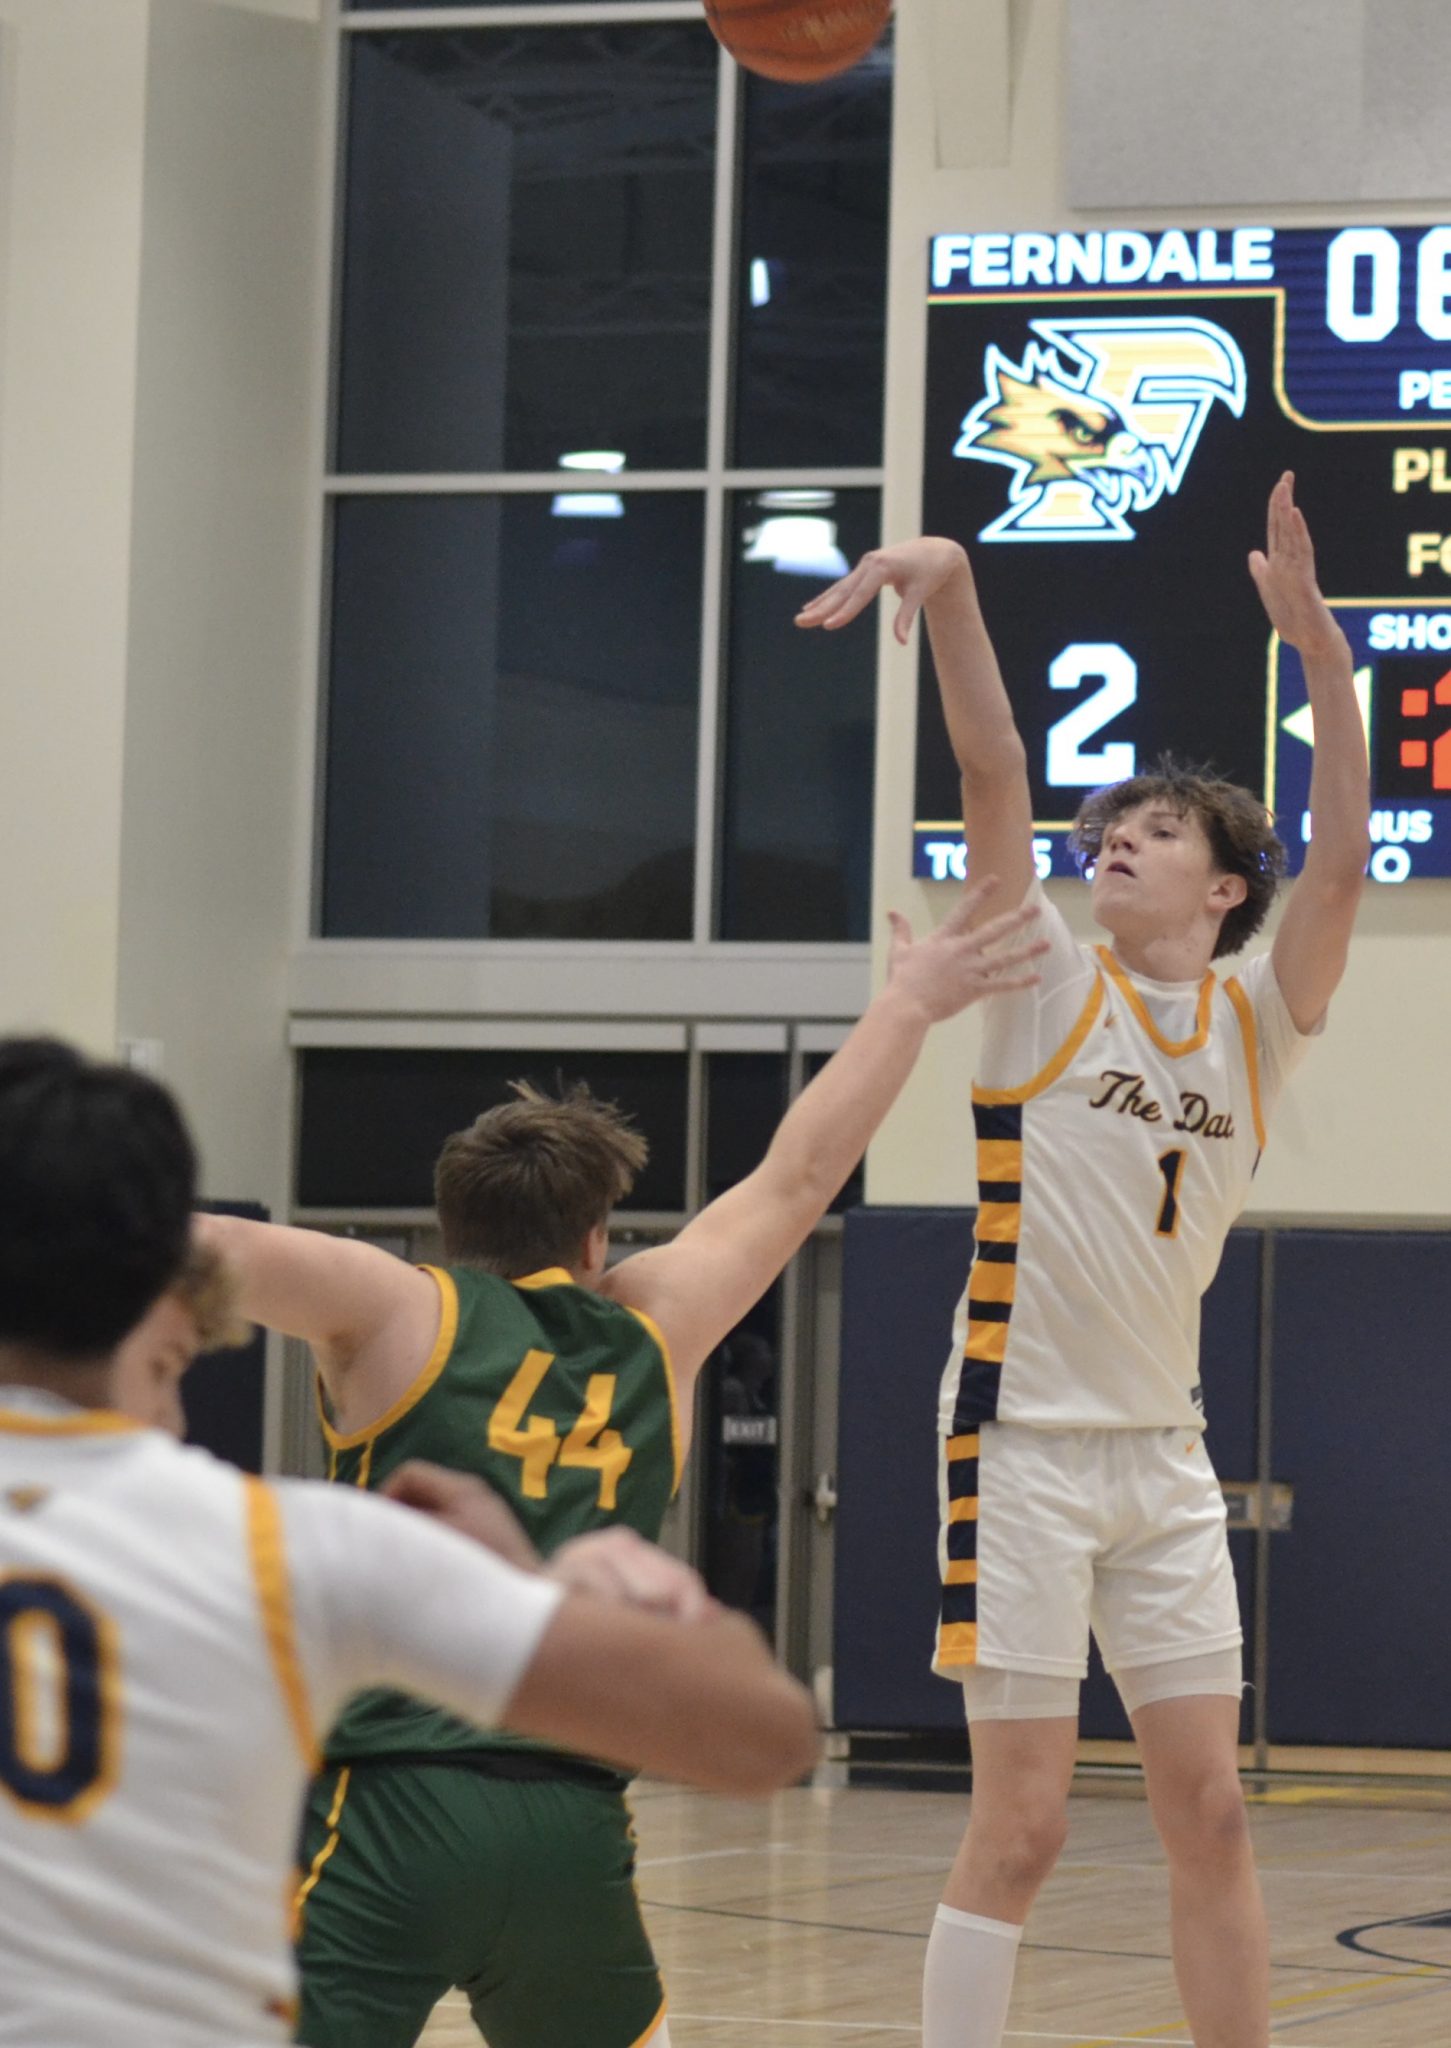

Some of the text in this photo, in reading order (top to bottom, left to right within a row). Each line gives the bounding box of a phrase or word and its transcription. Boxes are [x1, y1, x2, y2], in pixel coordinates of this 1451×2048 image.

[932, 227, 1276, 288] FERNDALE
[1046, 642, 1138, 787] 2
[1089, 1070, 1162, 1122] The
[1154, 1148, 1187, 1240] 1
[487, 1348, 633, 1511] 44
[0, 1566, 121, 1826] 0
